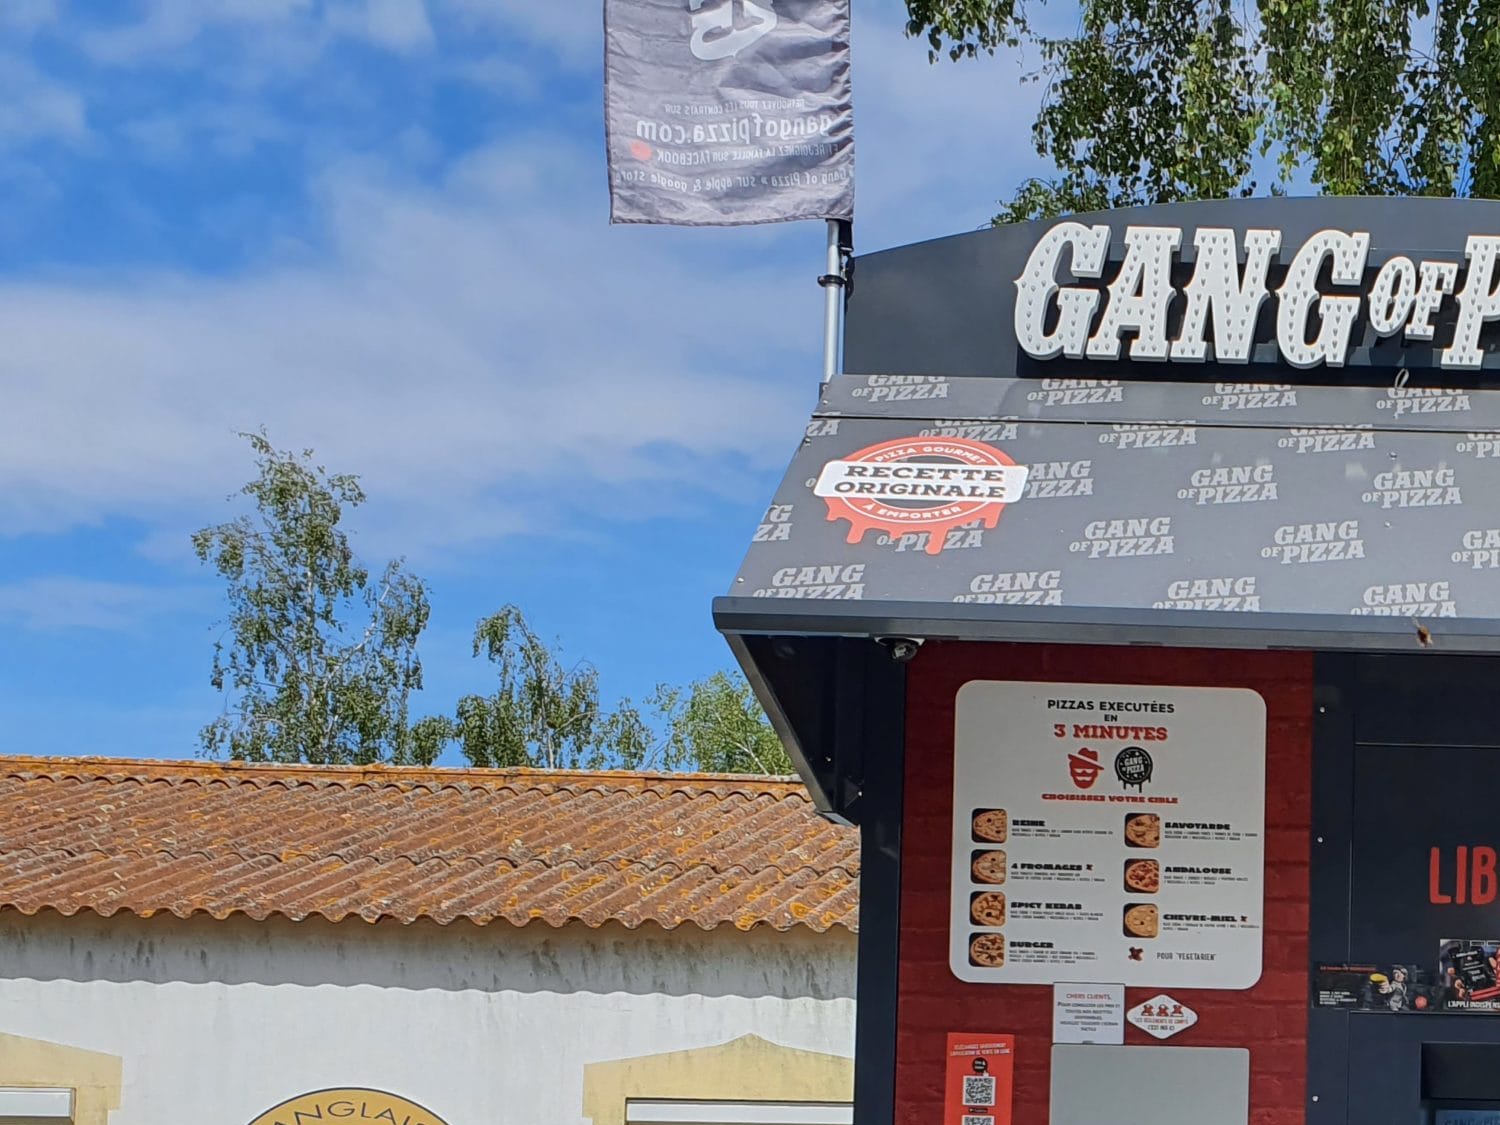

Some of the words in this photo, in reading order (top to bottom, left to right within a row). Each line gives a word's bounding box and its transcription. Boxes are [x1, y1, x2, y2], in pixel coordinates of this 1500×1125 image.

[1013, 221, 1370, 369] GANG
[1369, 255, 1458, 341] OF
[875, 447, 917, 463] PIZZA
[923, 446, 988, 464] GOURMET
[844, 465, 1003, 482] RECETTE
[1191, 464, 1274, 487] GANG
[1373, 469, 1456, 491] GANG
[834, 481, 1007, 499] ORIGINALE
[1177, 488, 1198, 500] OF
[1196, 482, 1278, 505] PIZZA
[1361, 491, 1381, 504] OF
[1380, 487, 1463, 509] PIZZA
[877, 506, 962, 519] EMPORTER
[1085, 517, 1171, 540] GANG
[1274, 520, 1359, 545] GANG
[1069, 541, 1090, 553] OF
[1087, 535, 1175, 559] PIZZA
[1260, 546, 1282, 559] OF
[1281, 539, 1366, 564] PIZZA
[1451, 551, 1472, 564] OF
[1048, 699, 1095, 710] PIZZAS
[1099, 700, 1175, 713] EXECUTÉES
[1104, 714, 1118, 722] EN
[1054, 723, 1066, 738] 3
[1073, 724, 1168, 741] MINUTES
[1157, 952, 1173, 960] POUR
